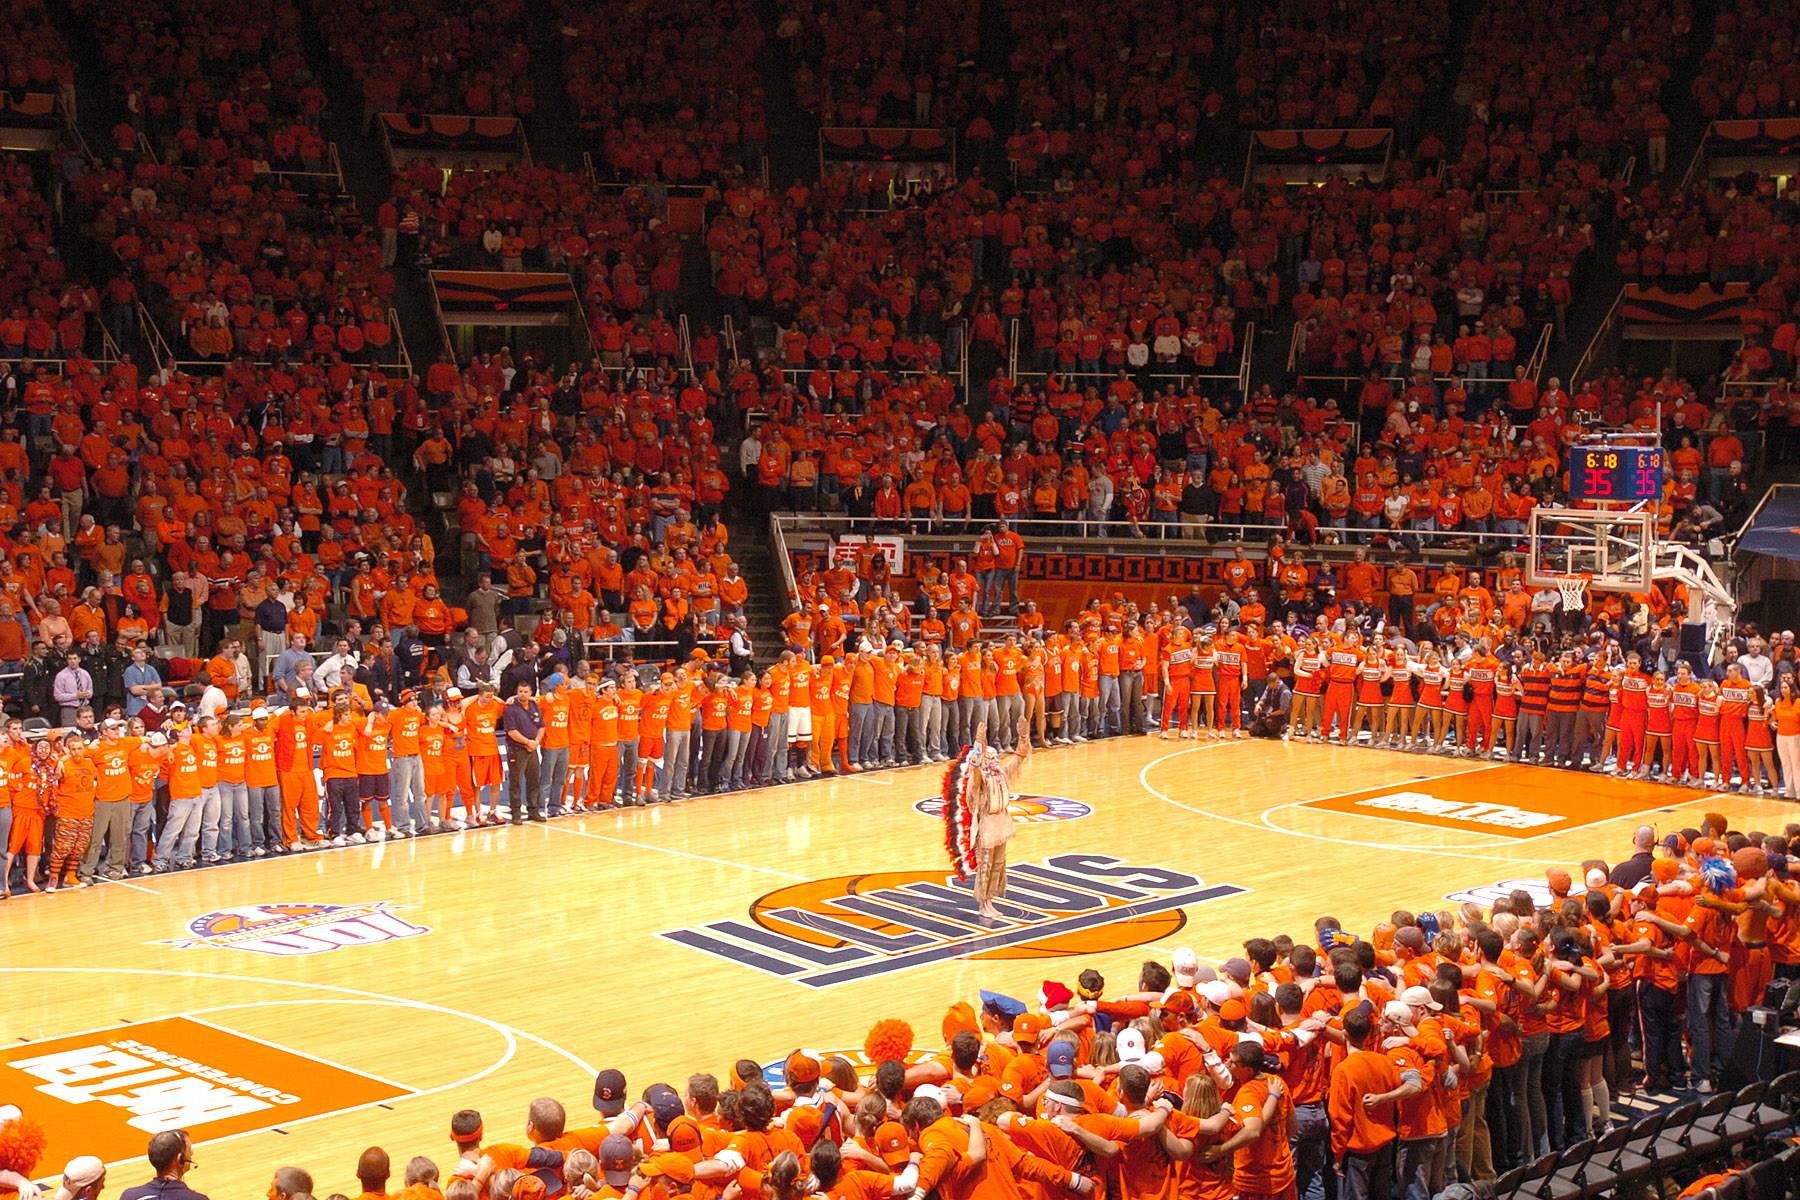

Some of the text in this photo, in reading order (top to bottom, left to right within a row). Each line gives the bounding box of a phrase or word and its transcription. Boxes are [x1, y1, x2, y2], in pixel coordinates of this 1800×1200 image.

[1586, 453, 1617, 469] 6:18
[1638, 453, 1660, 469] 6:18
[1583, 468, 1612, 495] 35
[1635, 469, 1656, 496] 35
[657, 854, 1204, 977] ILLINOIS
[110, 1039, 301, 1105] CONFERENCE
